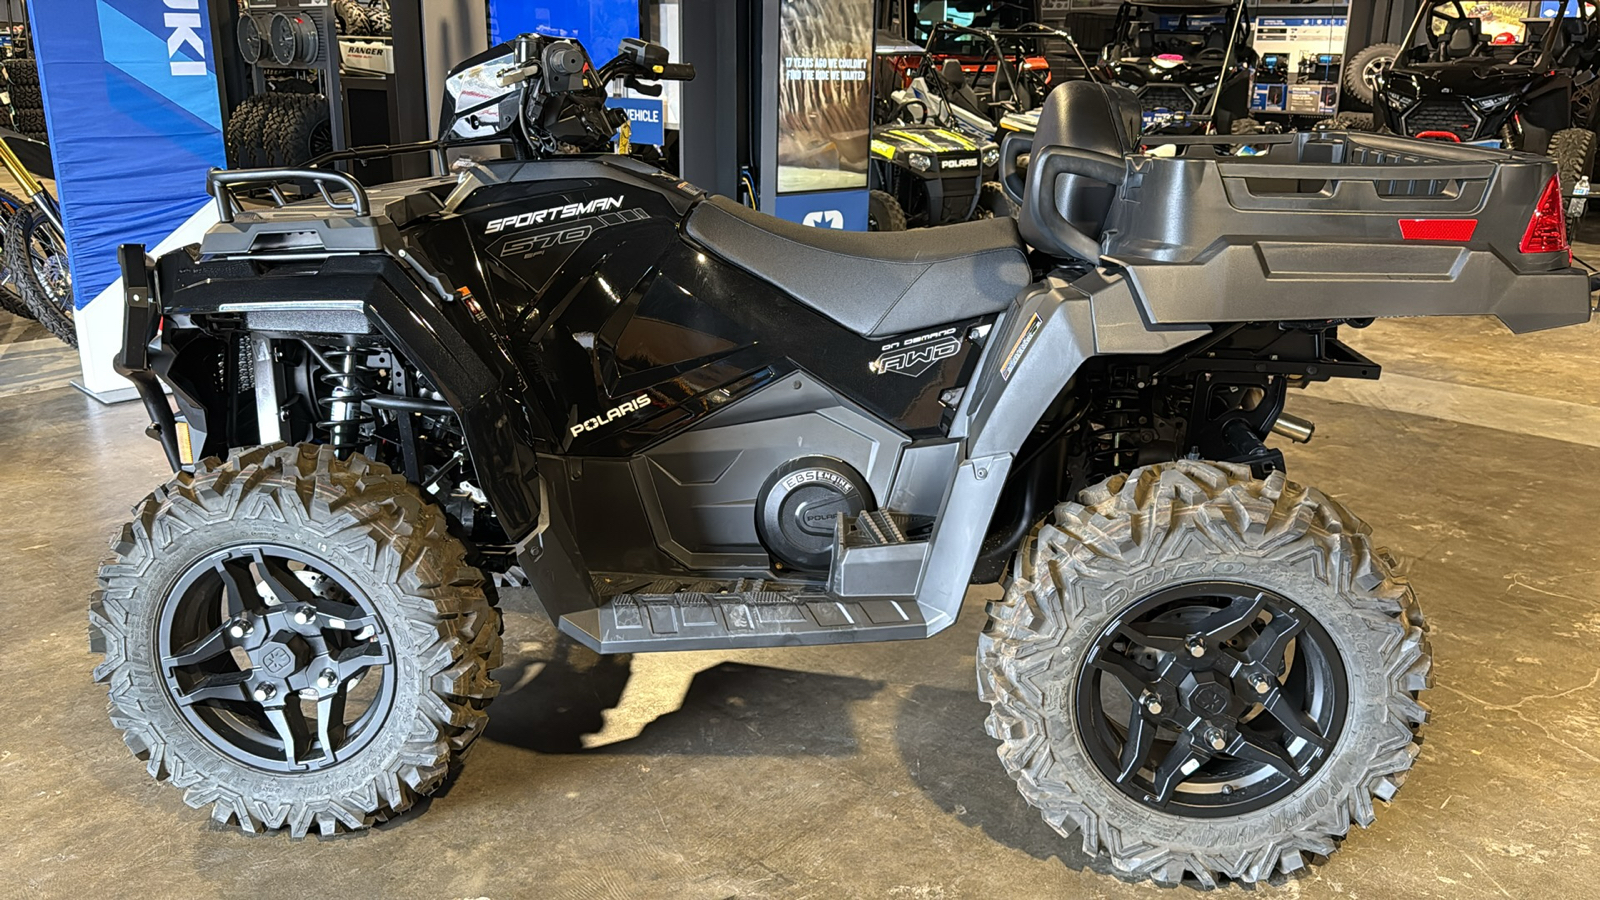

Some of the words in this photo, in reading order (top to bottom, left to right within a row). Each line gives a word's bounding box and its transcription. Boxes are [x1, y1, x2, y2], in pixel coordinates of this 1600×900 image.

[163, 0, 207, 76] KI
[348, 47, 384, 55] RANGER
[794, 58, 813, 67] YEARS
[815, 58, 827, 67] AGO
[828, 58, 837, 68] WE
[802, 70, 814, 80] THE
[815, 70, 829, 80] RIDE
[830, 71, 840, 80] WE
[841, 71, 866, 80] WANTED
[942, 158, 977, 169] POLARIS
[485, 195, 624, 234] SPORTSMAN
[501, 225, 593, 257] 570
[878, 339, 961, 374] AWD
[570, 394, 651, 437] POLARIS
[786, 471, 815, 488] EBS
[818, 471, 852, 490] ENGINE
[807, 513, 838, 521] POLAR
[1103, 562, 1246, 614] DURO
